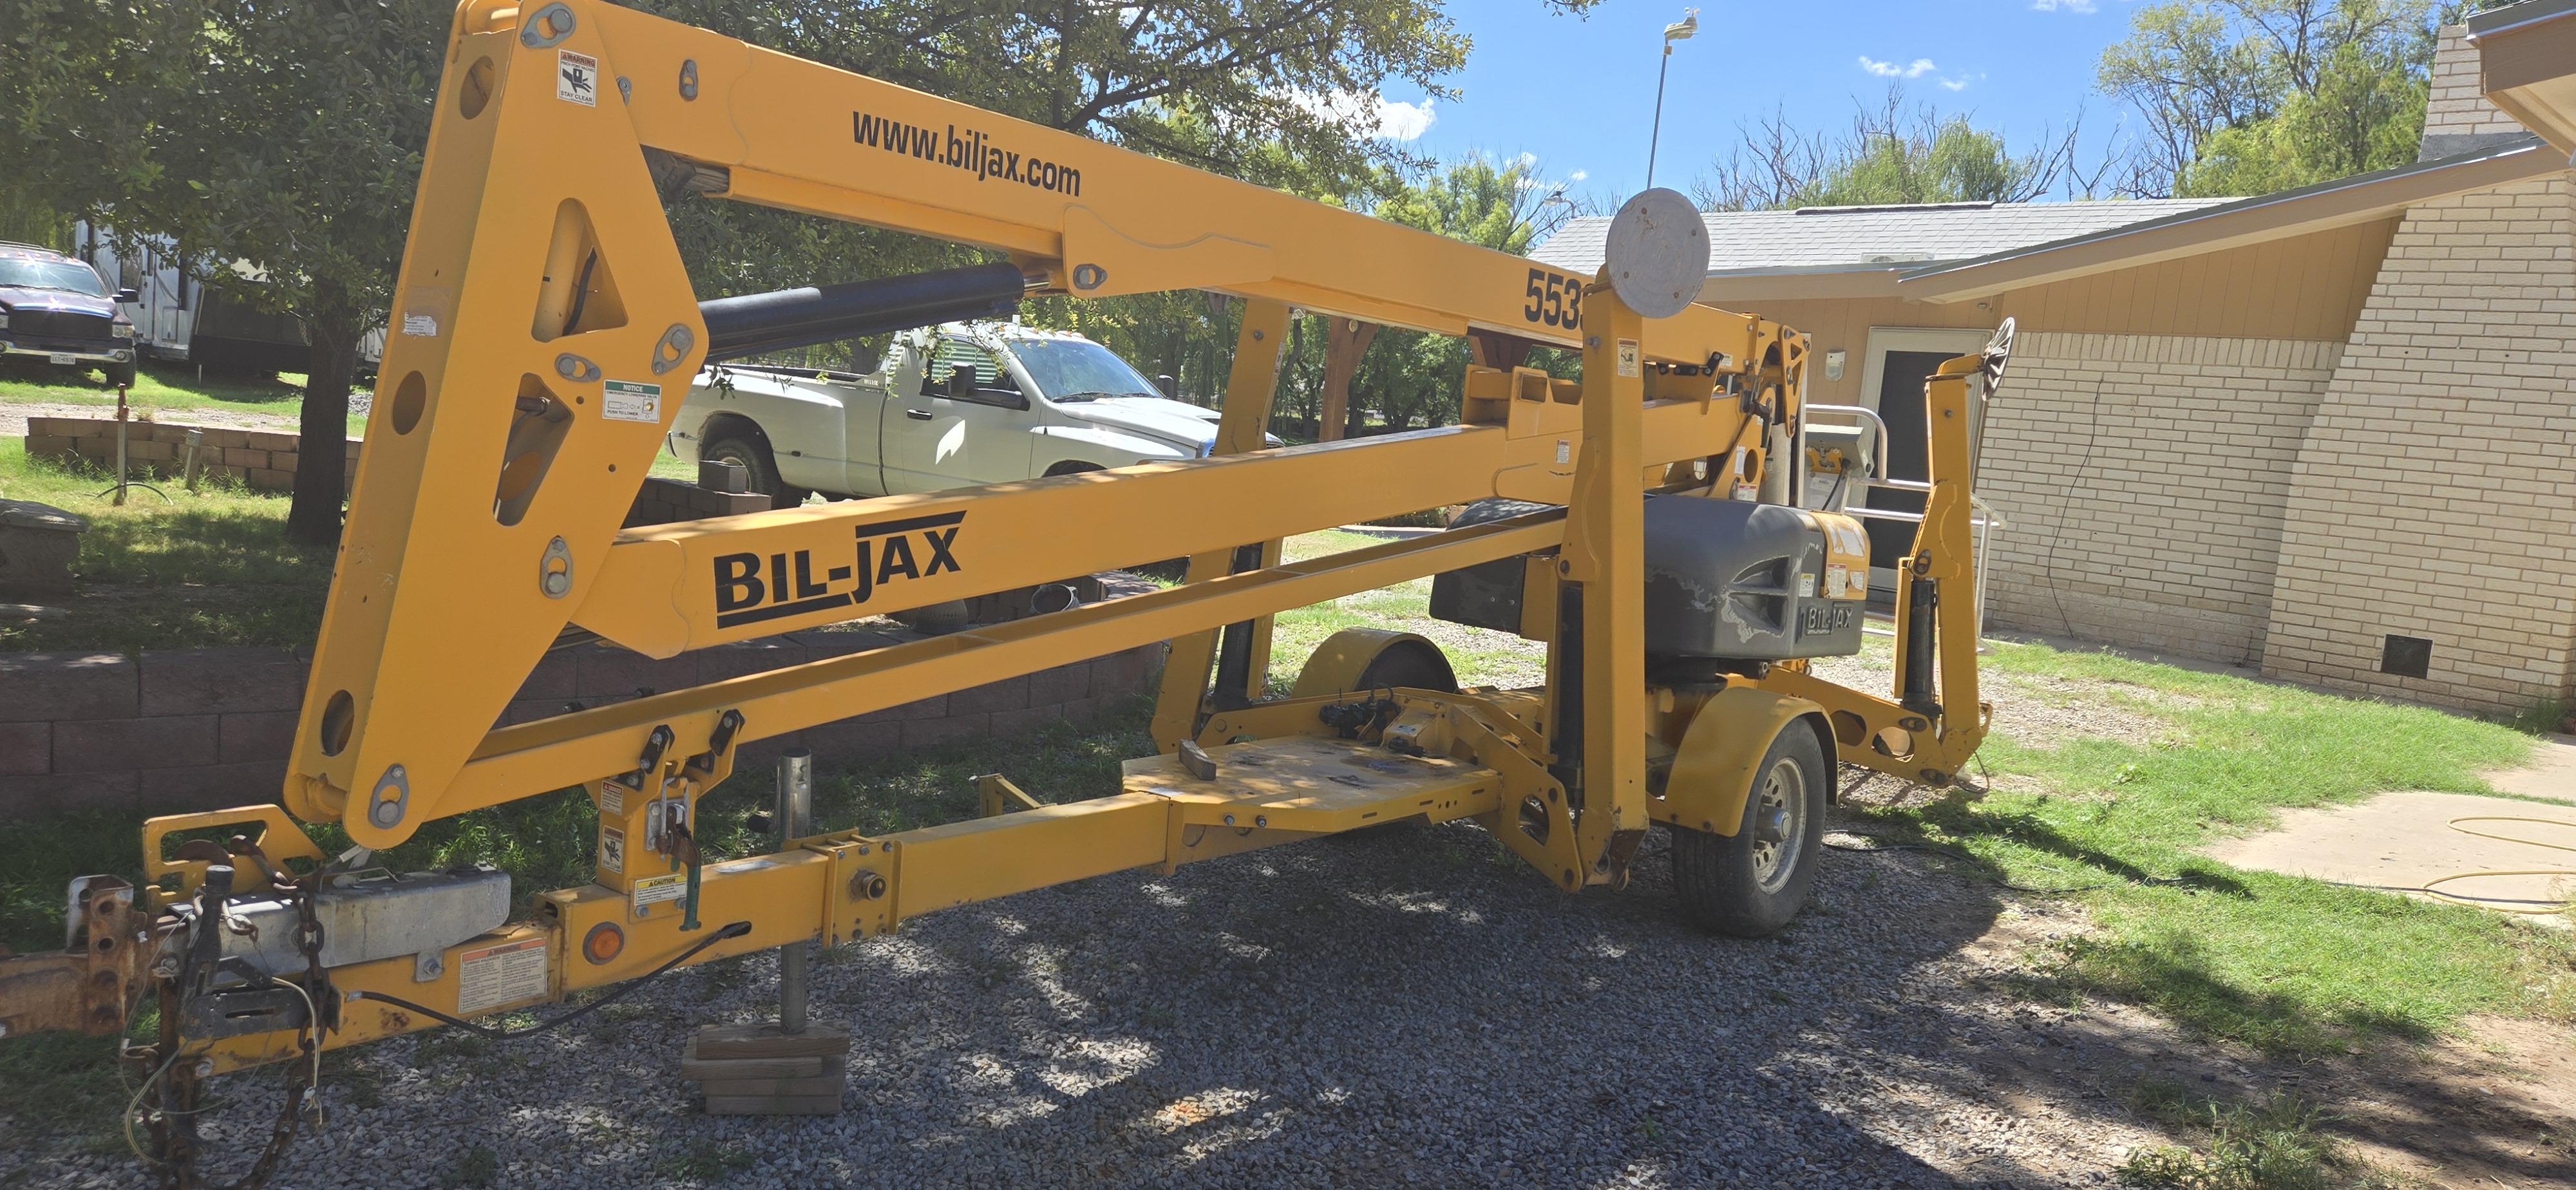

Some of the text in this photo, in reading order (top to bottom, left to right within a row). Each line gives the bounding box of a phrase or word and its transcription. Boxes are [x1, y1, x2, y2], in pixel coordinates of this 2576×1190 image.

[567, 53, 596, 67] WARNING
[574, 94, 592, 102] CLEAR
[852, 110, 1081, 197] www.biljax.com
[1524, 267, 1594, 333] 553
[623, 384, 643, 392] NOTICE
[714, 523, 963, 614] BIL-JAX
[1806, 607, 1853, 634] BIL-JAX
[654, 876, 676, 886] CAUTION
